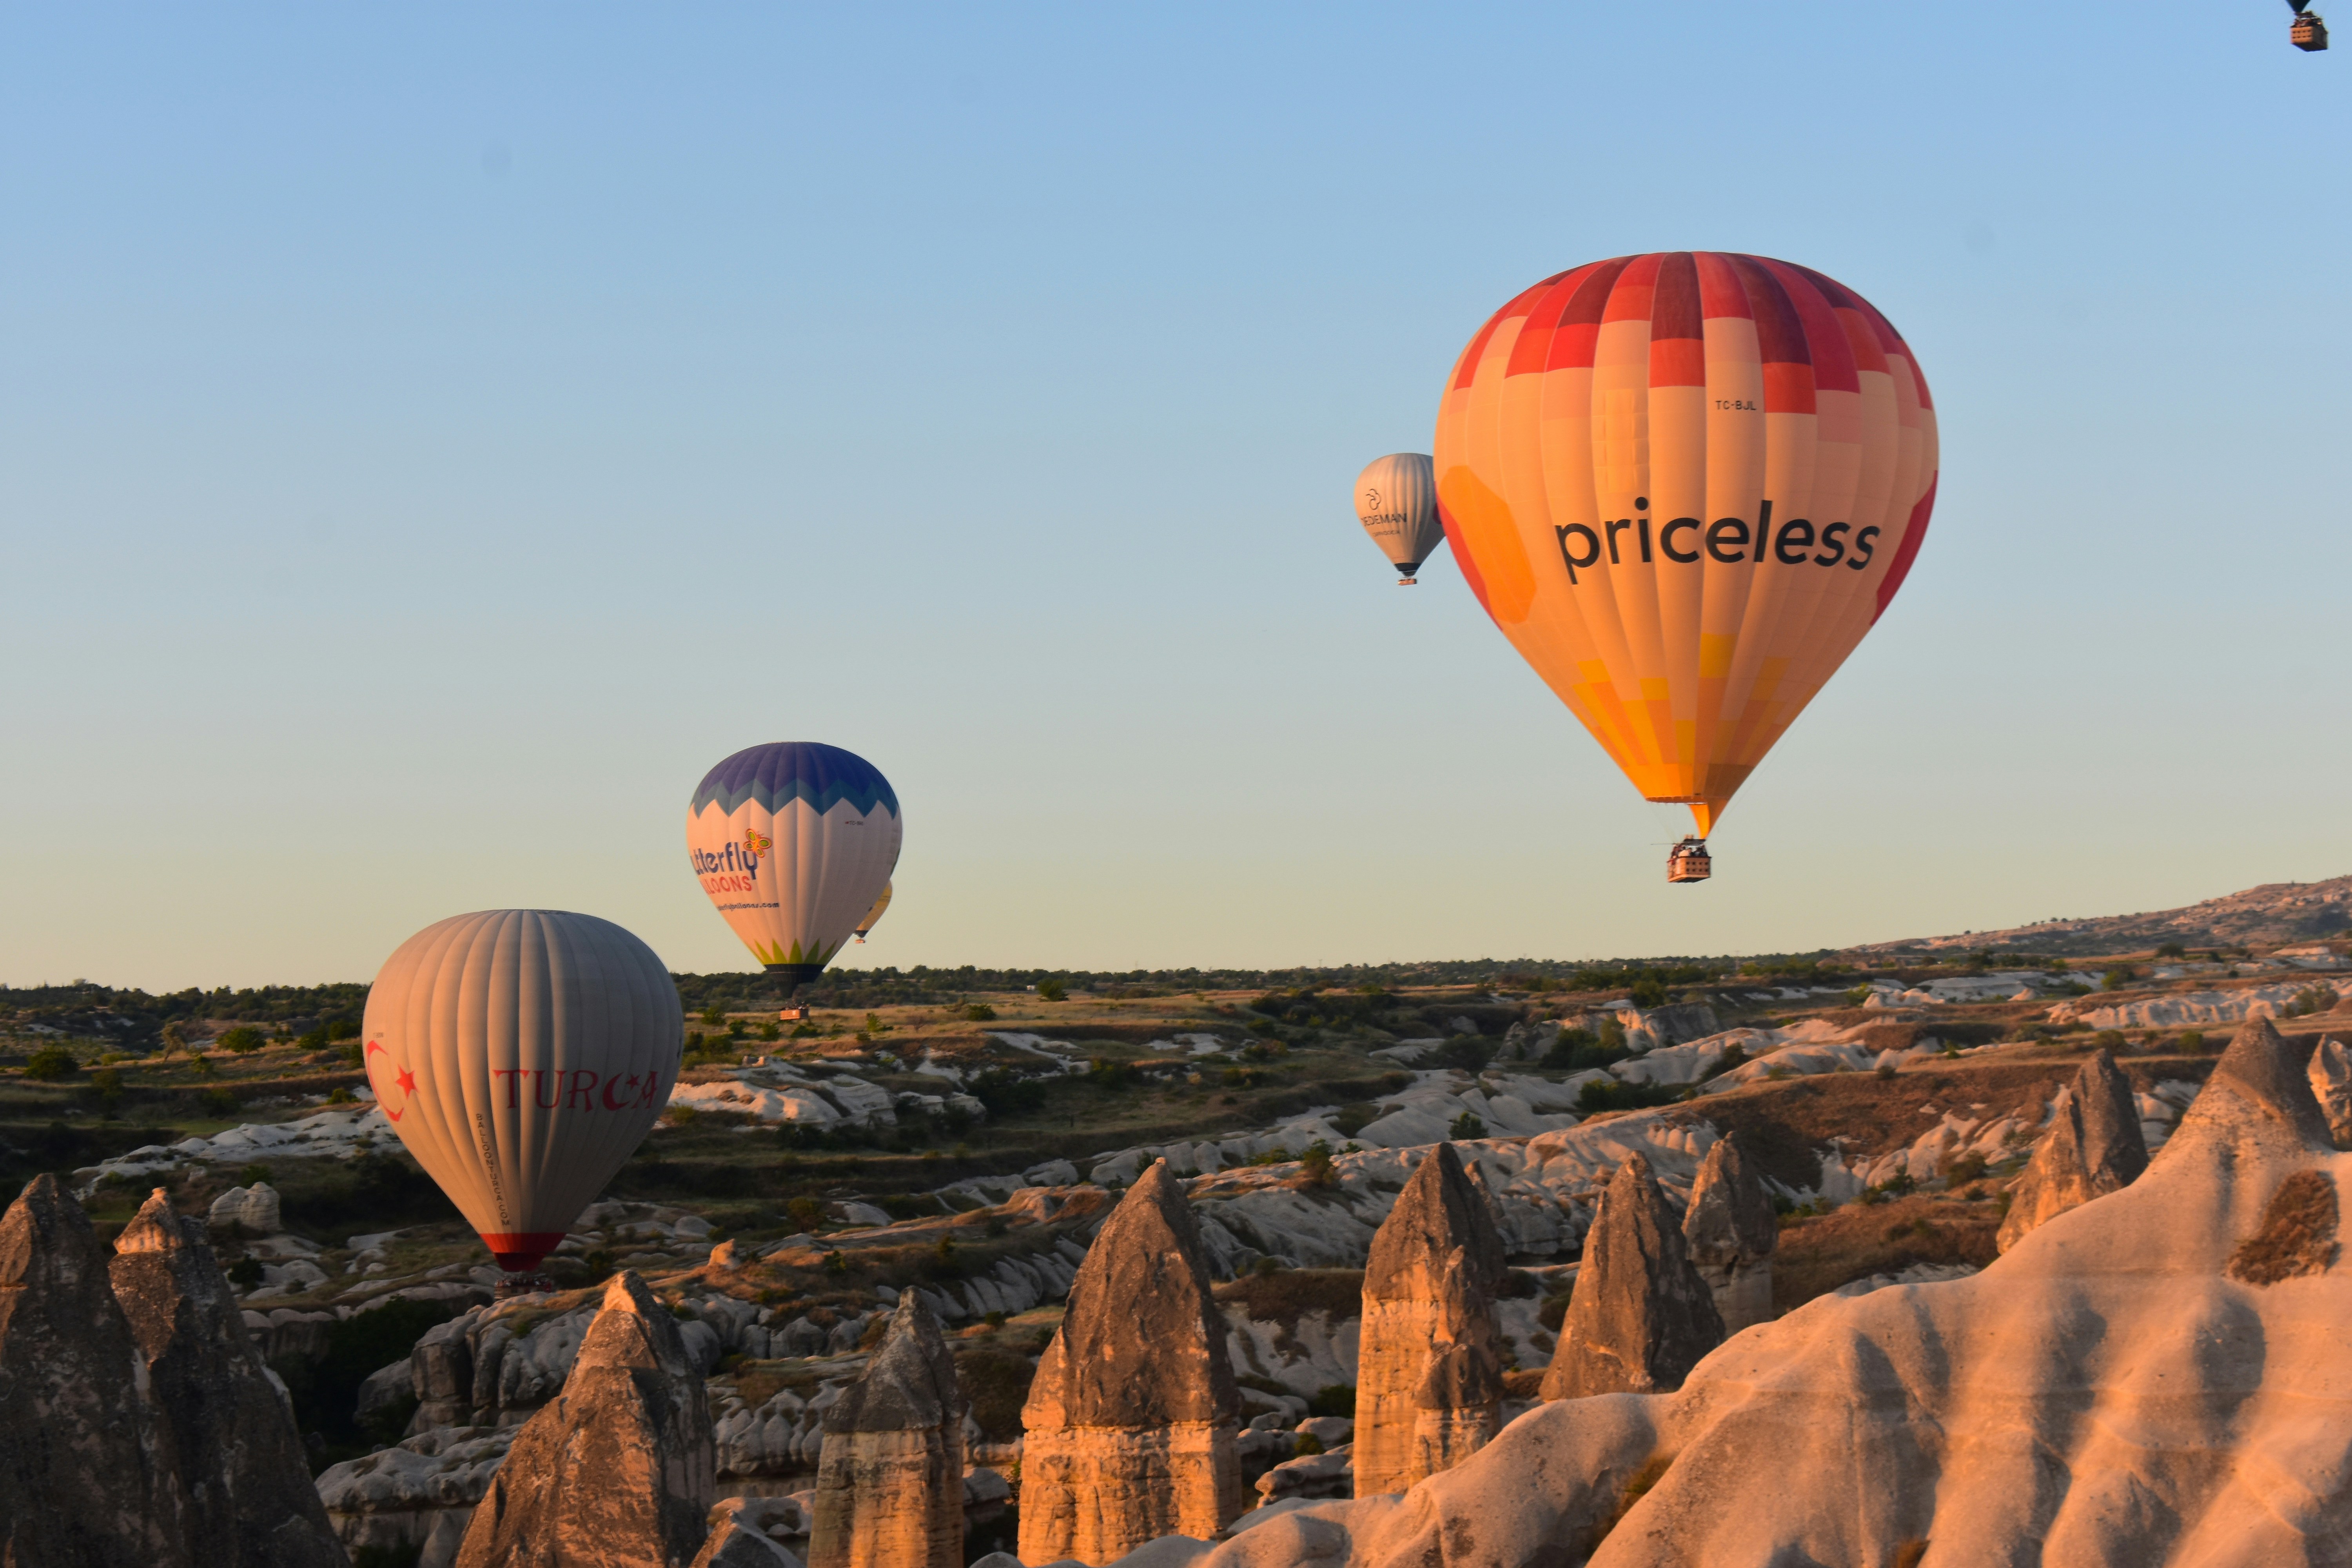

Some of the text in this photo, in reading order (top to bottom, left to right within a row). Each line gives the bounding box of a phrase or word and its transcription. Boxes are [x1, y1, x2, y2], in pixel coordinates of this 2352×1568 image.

[1715, 400, 1757, 410] TC-BJL
[1554, 497, 1880, 585] priceless
[492, 1069, 658, 1112] TURCA
[476, 1113, 510, 1225] BALLOONTURCA.COM
